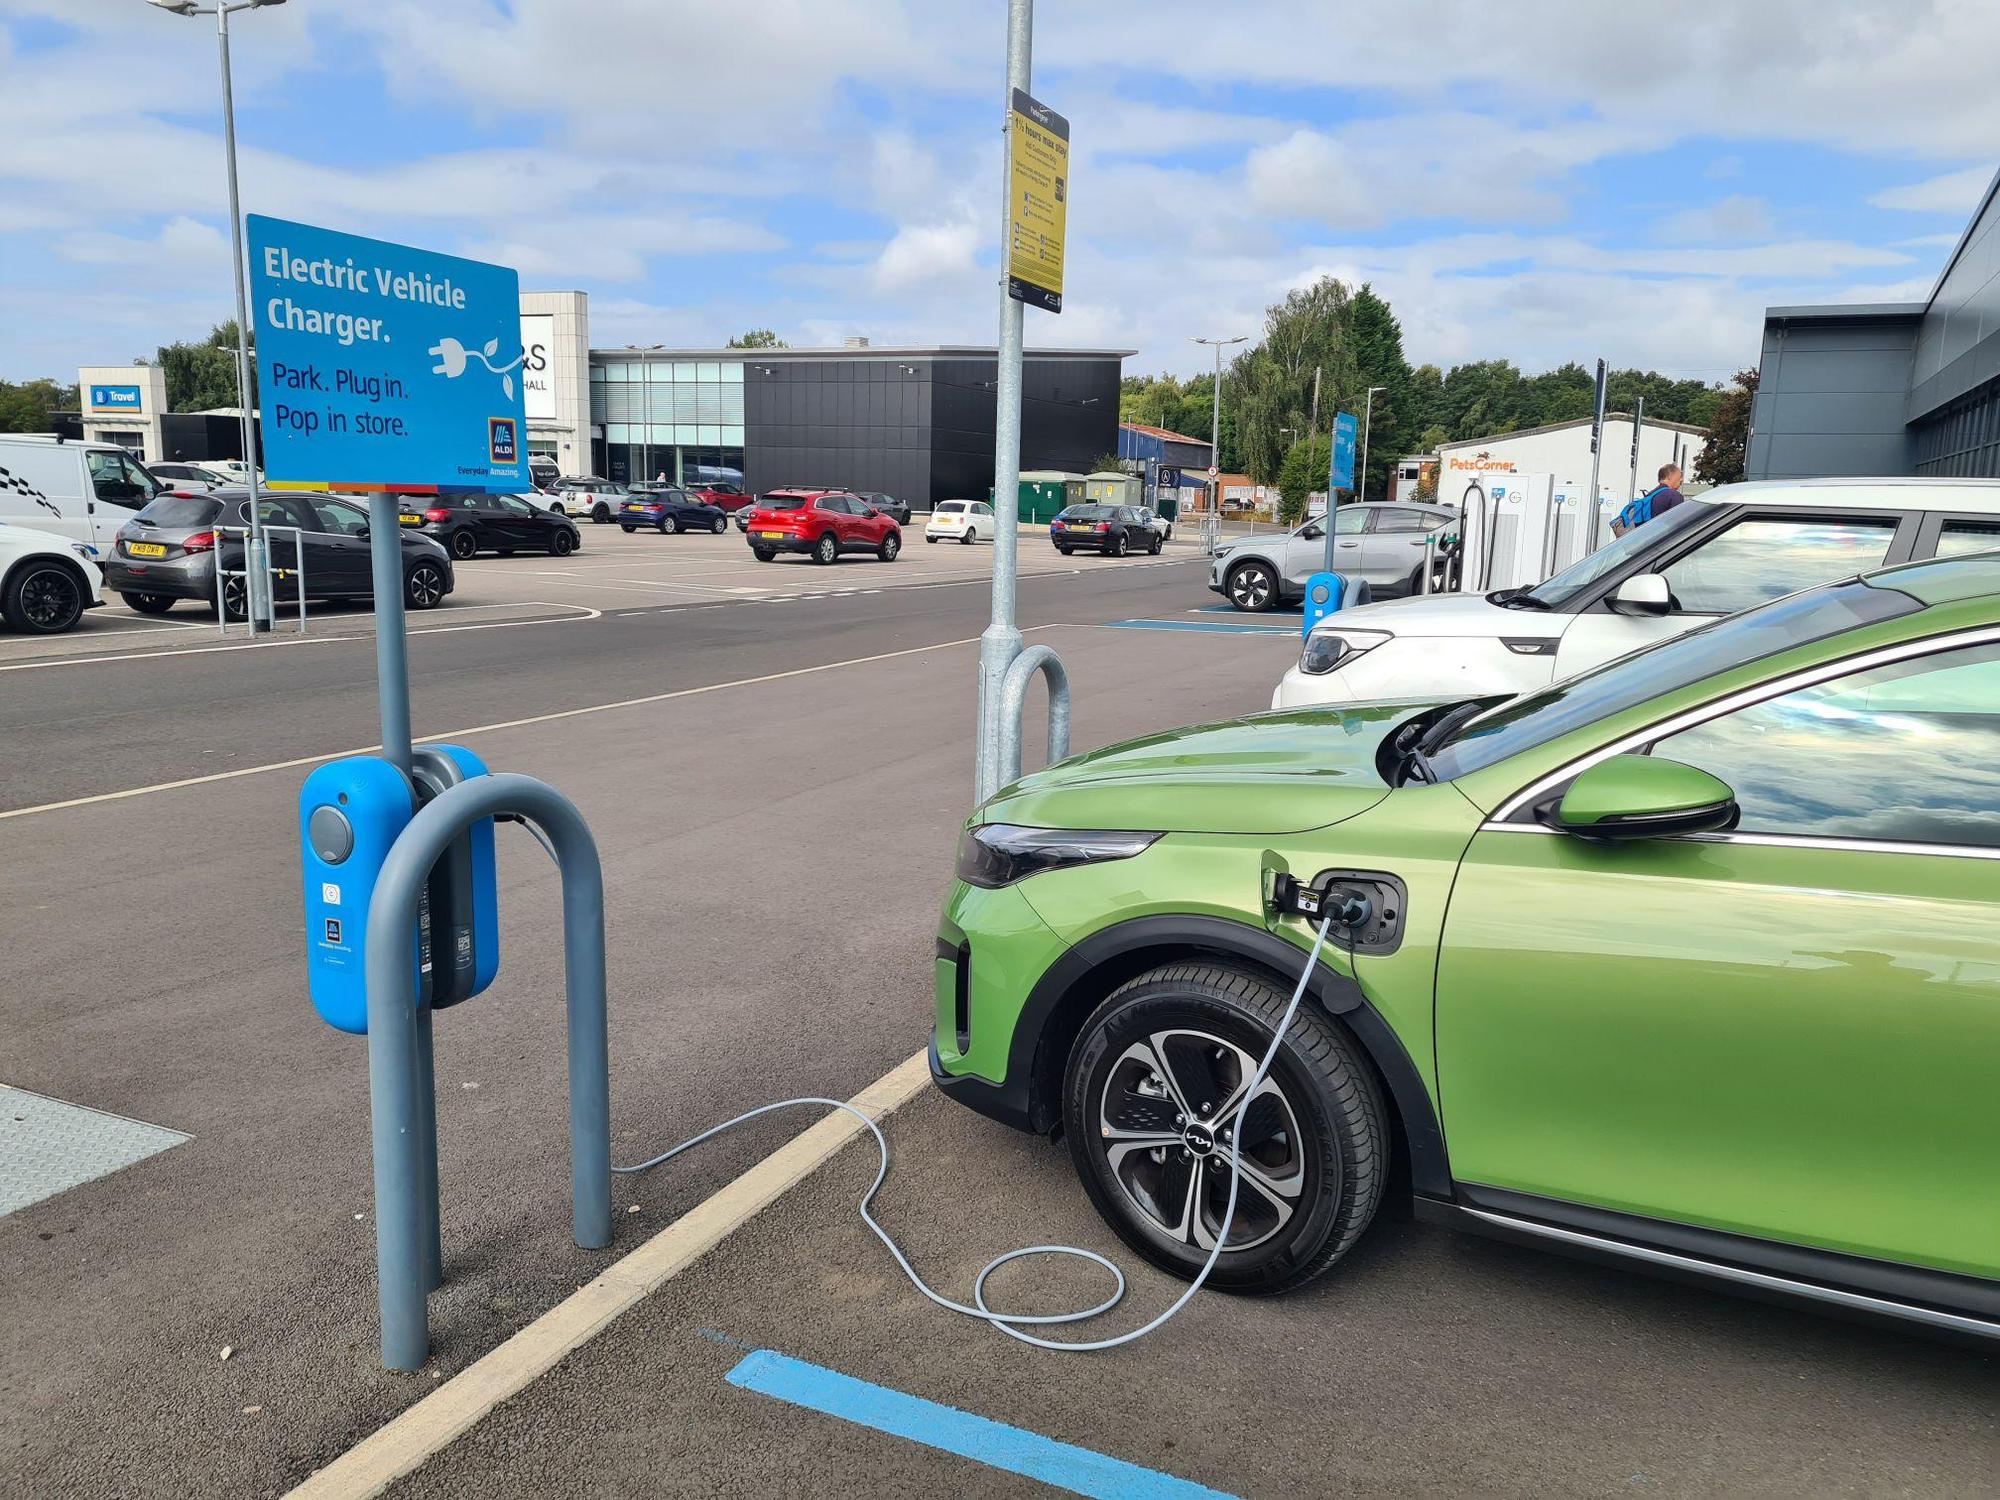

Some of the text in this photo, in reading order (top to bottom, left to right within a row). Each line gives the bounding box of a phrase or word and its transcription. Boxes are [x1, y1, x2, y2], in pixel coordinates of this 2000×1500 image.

[1025, 123, 1041, 142] hours
[1042, 136, 1054, 150] max
[1055, 143, 1066, 159] stay
[264, 246, 466, 310] Electric Vehicle
[267, 298, 391, 346] Charger.
[109, 390, 136, 402] Travel
[272, 362, 409, 403] Park. Plug in.
[275, 404, 408, 437] Pop in store.
[494, 445, 513, 454] ALDI
[1449, 457, 1515, 471] PetsCorner
[457, 465, 520, 479] Everyday Amazing.
